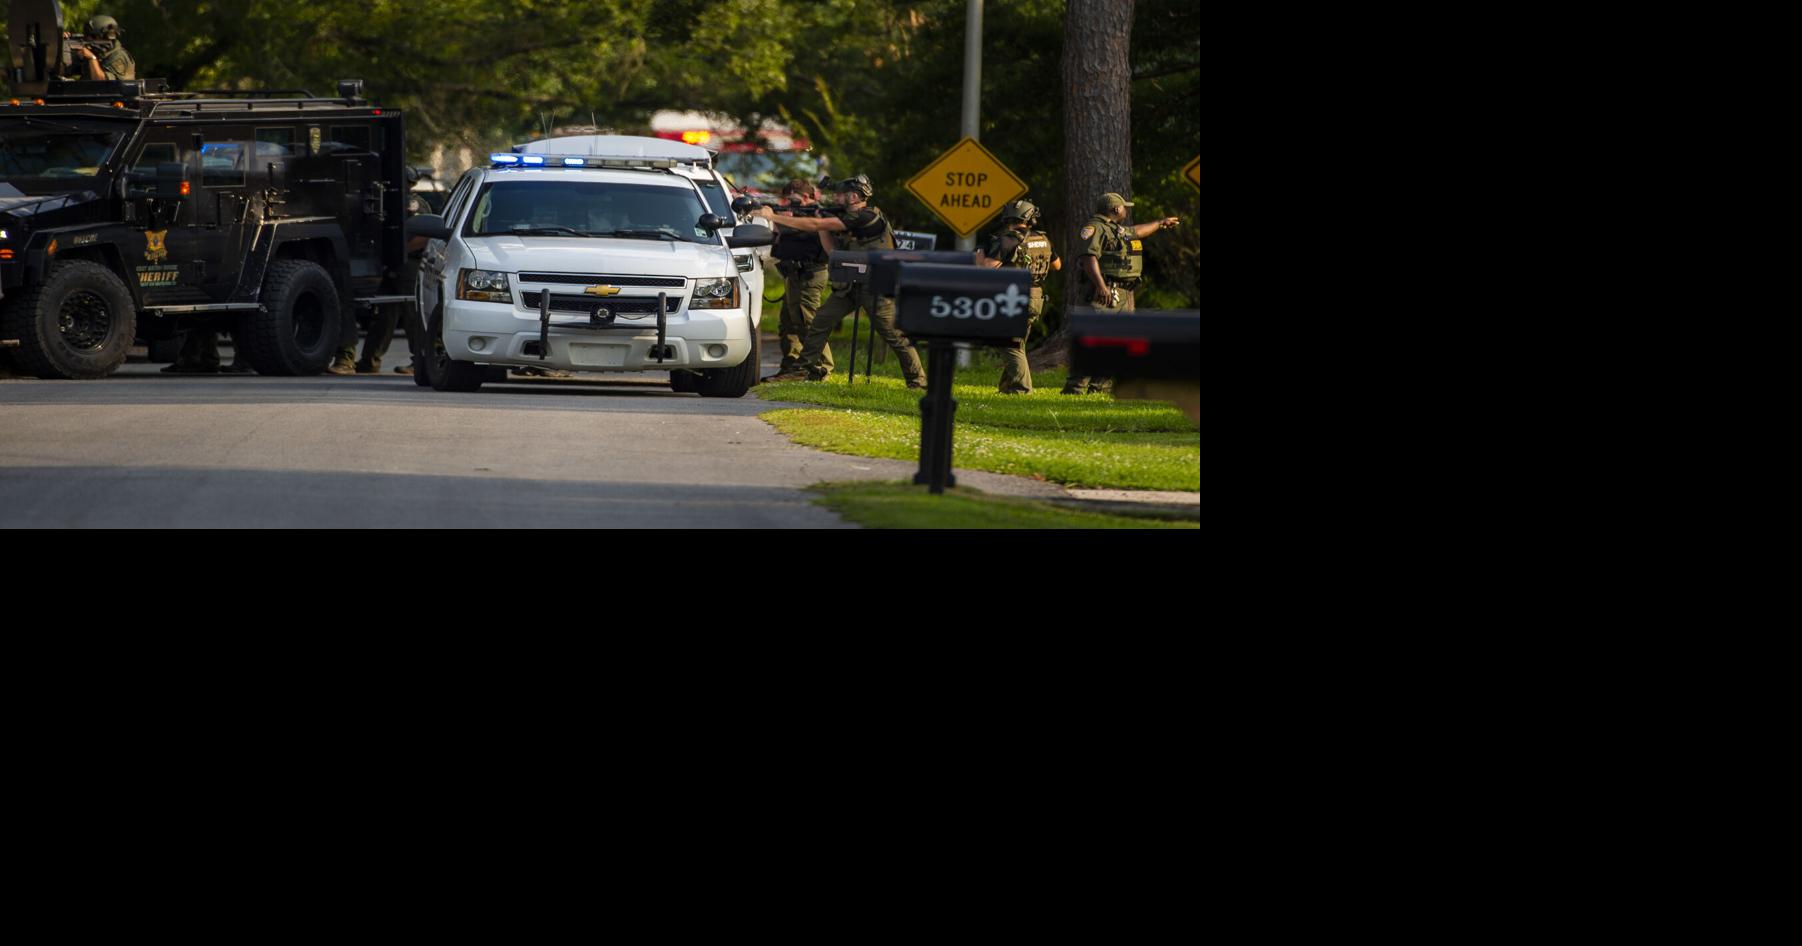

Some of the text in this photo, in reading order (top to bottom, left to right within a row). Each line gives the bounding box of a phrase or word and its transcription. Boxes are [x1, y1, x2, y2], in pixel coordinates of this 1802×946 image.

[945, 172, 988, 187] STOP
[940, 193, 992, 208] AHEAD
[930, 295, 997, 320] 530
